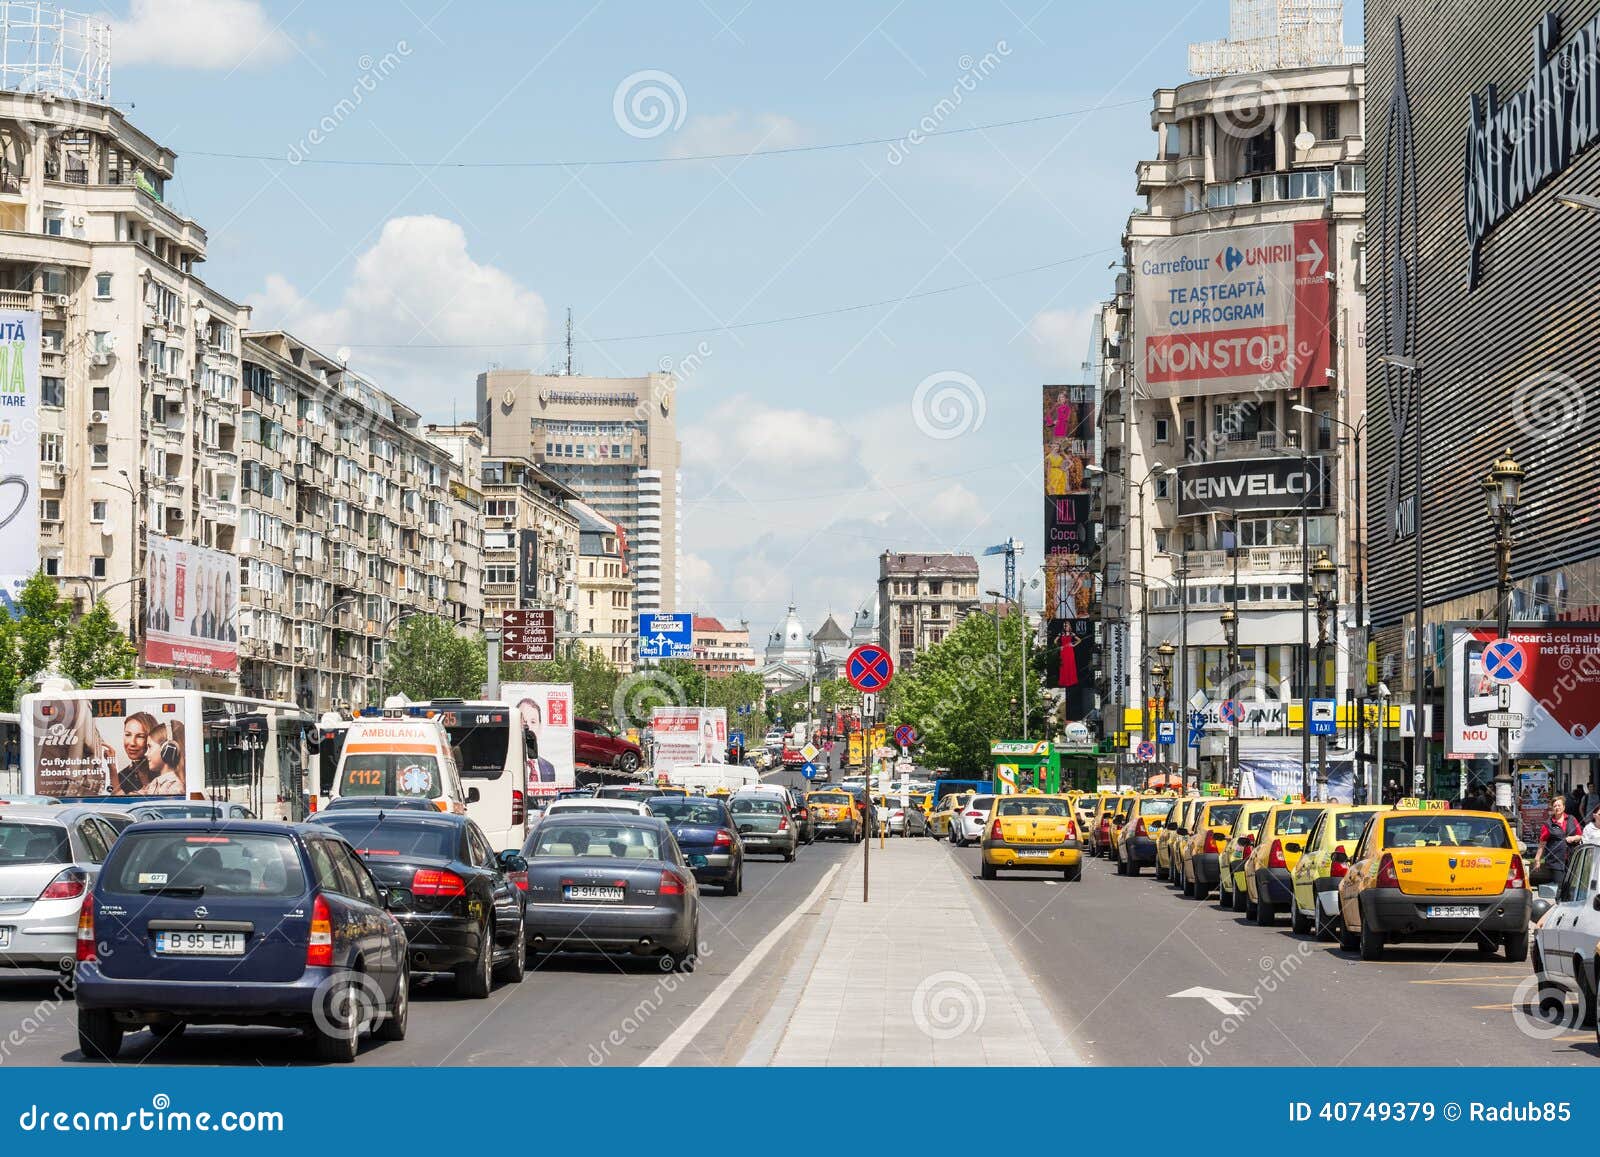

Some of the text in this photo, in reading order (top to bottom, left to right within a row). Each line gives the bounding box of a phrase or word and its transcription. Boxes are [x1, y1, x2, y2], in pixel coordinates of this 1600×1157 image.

[1142, 244, 1292, 276] Carrefour UNIRII
[1168, 288, 1188, 304] TE
[1169, 303, 1265, 326] CU PROGRAM
[1182, 473, 1311, 500] KENVELO
[1554, 633, 1571, 643] cel
[1572, 633, 1593, 643] mai
[1540, 646, 1559, 655] net
[1560, 644, 1581, 655] fără
[96, 700, 123, 717] 104
[1315, 723, 1331, 732] TAXI
[1462, 731, 1488, 741] NOU
[40, 758, 54, 766] Cu
[54, 757, 91, 767] flydubai
[40, 768, 71, 776] zboară
[1427, 800, 1443, 809] TAXI
[571, 886, 579, 897] B
[582, 887, 598, 897] 914
[599, 887, 622, 898] RVN
[170, 933, 236, 950] B 95 EAI
